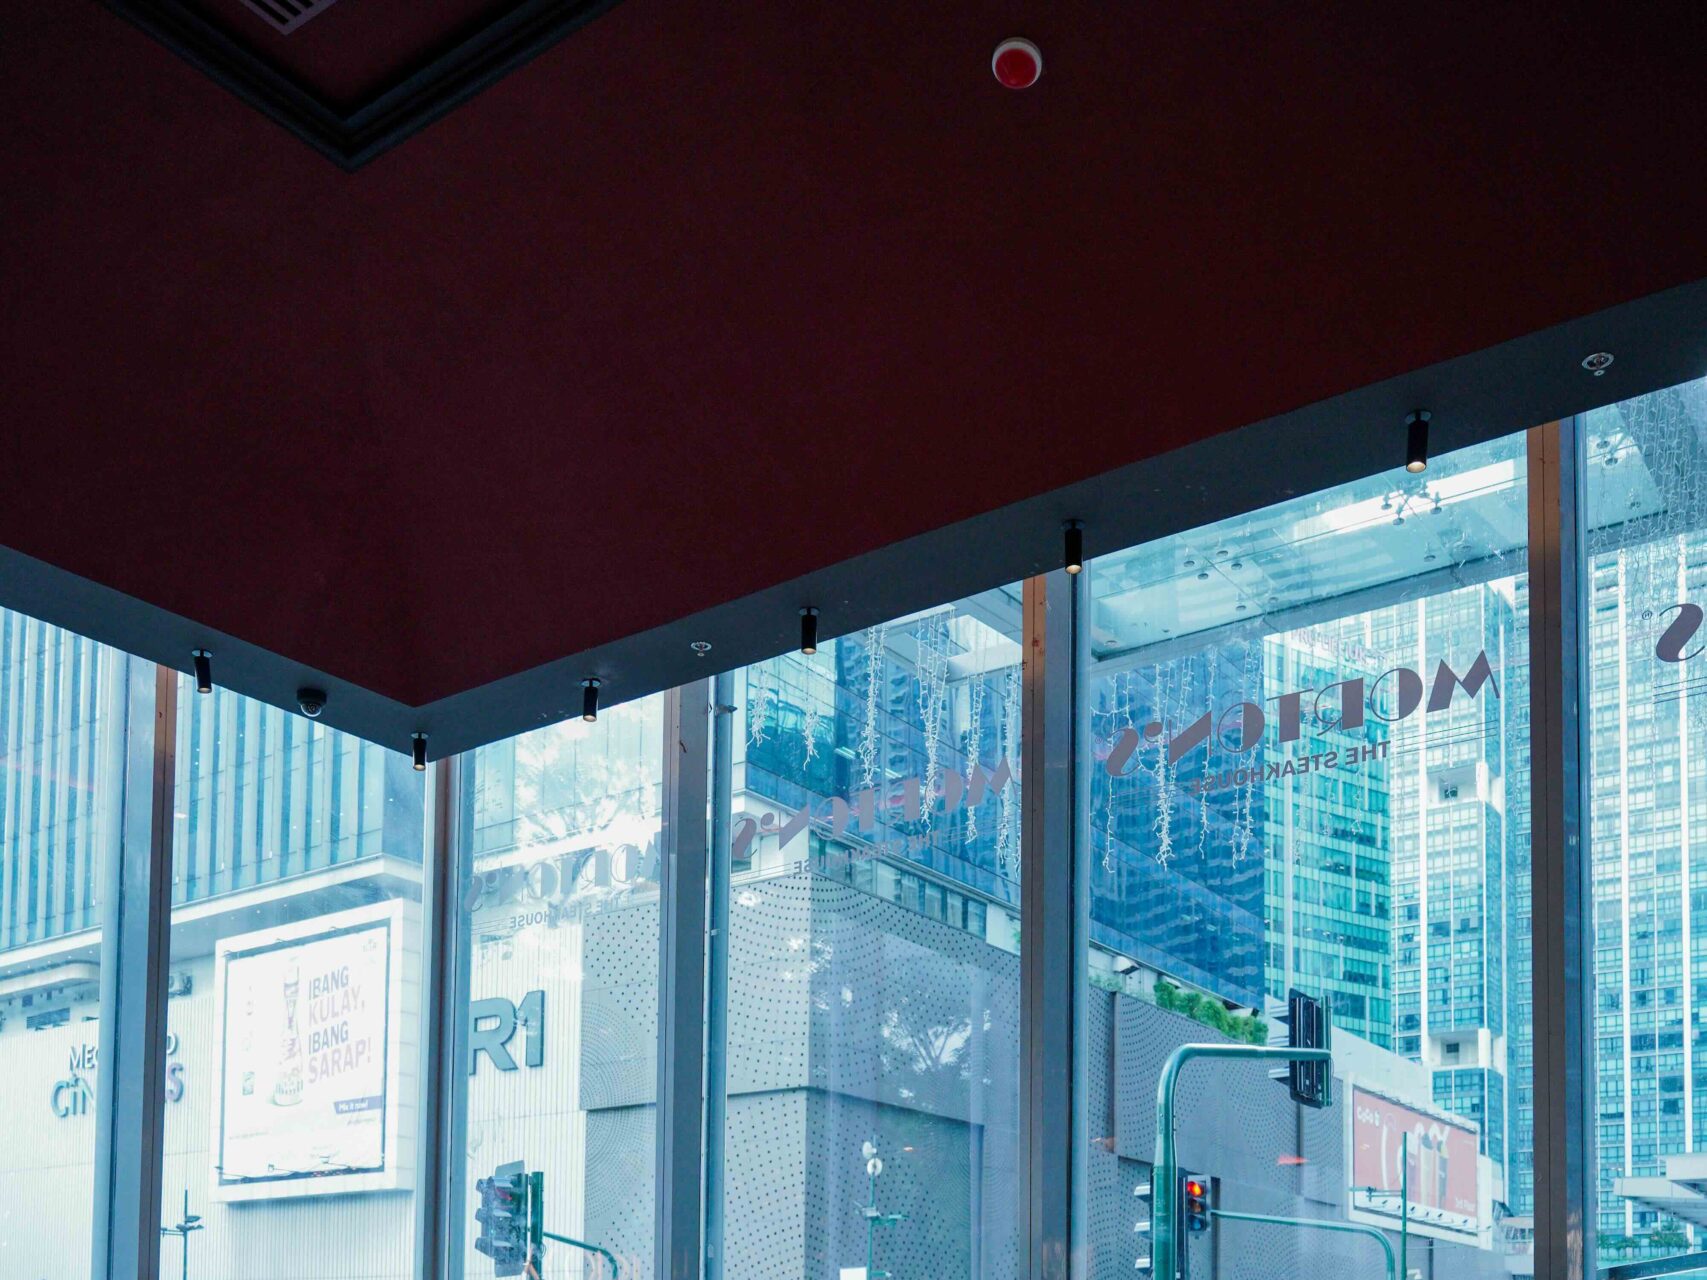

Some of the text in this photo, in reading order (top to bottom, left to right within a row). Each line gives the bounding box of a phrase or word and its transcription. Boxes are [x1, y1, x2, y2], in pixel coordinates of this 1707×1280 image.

[308, 966, 350, 1000] IBANG
[308, 984, 366, 1027] KULAY,
[308, 1020, 350, 1055] IBANG
[308, 1036, 372, 1085] SARAP!
